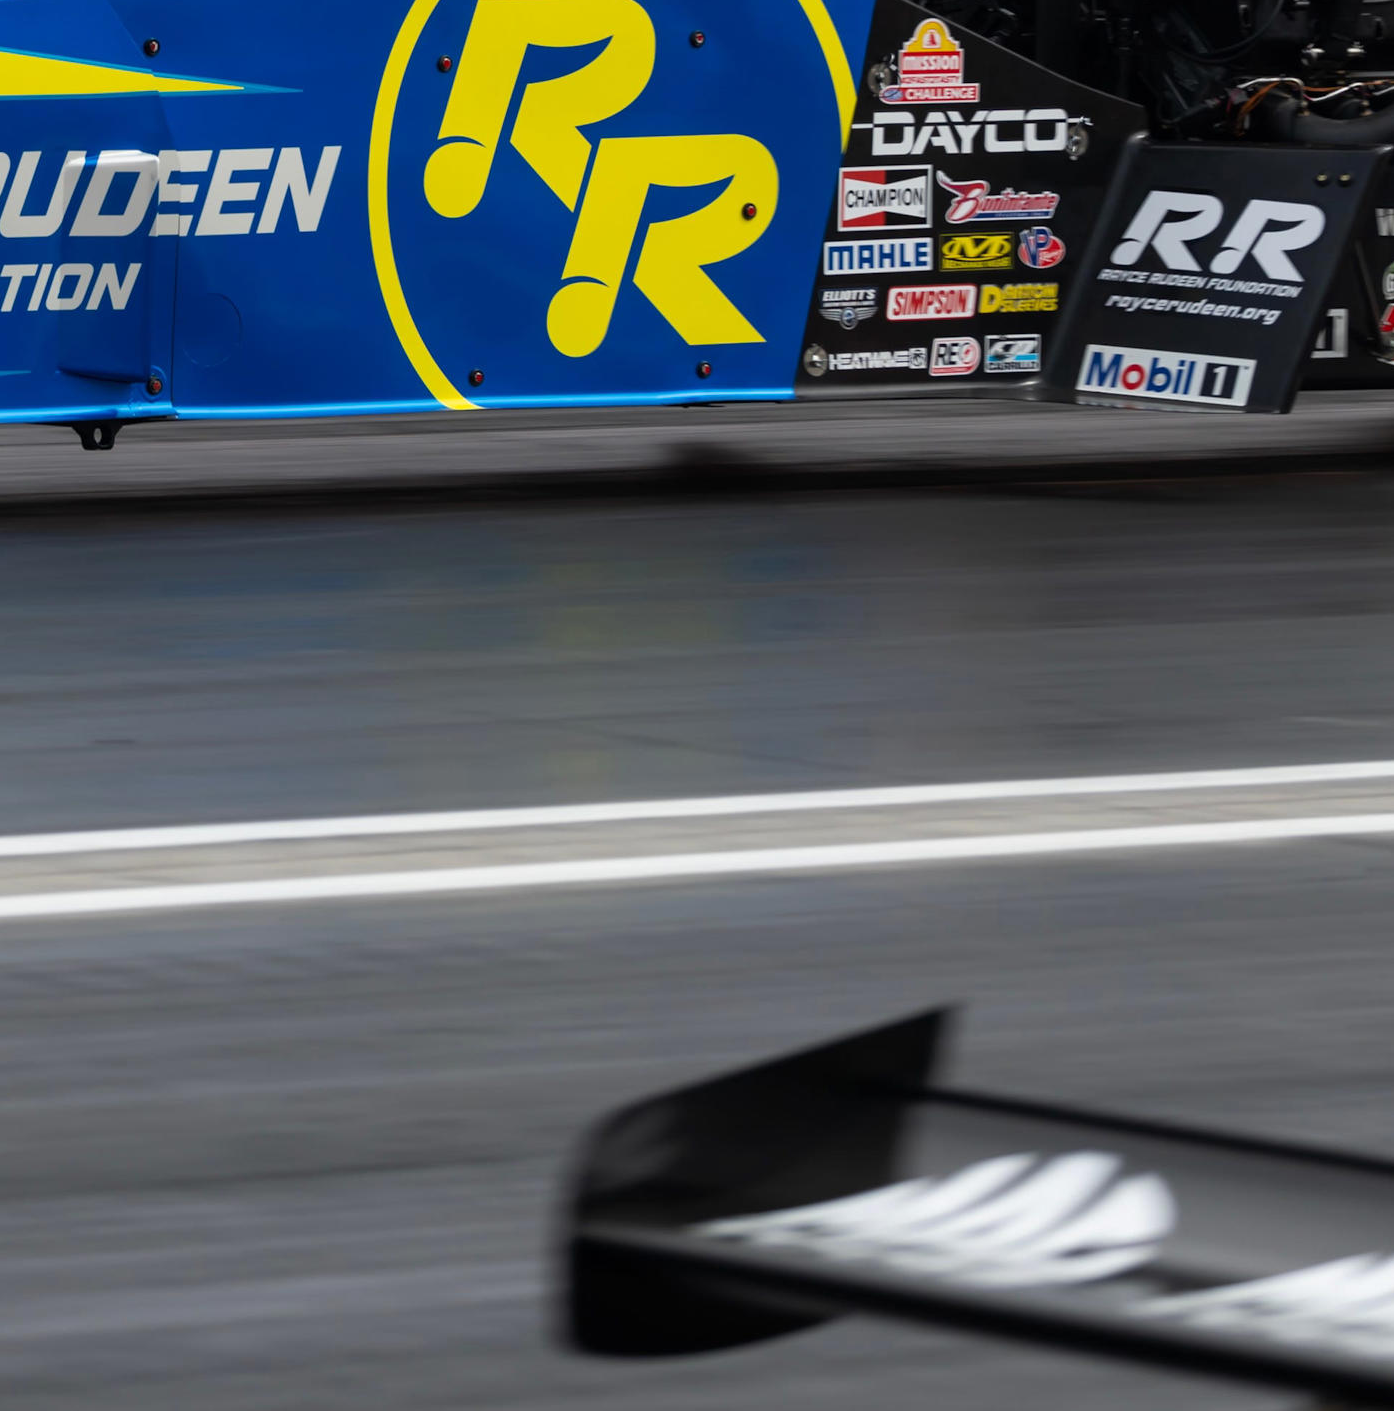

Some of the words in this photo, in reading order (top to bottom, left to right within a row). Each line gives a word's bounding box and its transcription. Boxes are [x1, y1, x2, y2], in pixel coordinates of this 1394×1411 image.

[905, 88, 976, 101] CHALLENGE
[871, 108, 1068, 156] DAYCO
[845, 188, 923, 208] CHAMPION
[1110, 190, 1326, 283] RR
[828, 242, 928, 271] MAHLE
[1097, 269, 1149, 283] RAYCE
[1148, 273, 1207, 288] RUDEEN
[1207, 278, 1303, 298] FOUNDATION
[893, 290, 970, 317] SIMPSON
[1105, 295, 1282, 326] raycerudeen.org
[1085, 351, 1196, 395] Mobil
[1212, 365, 1227, 396] 1
